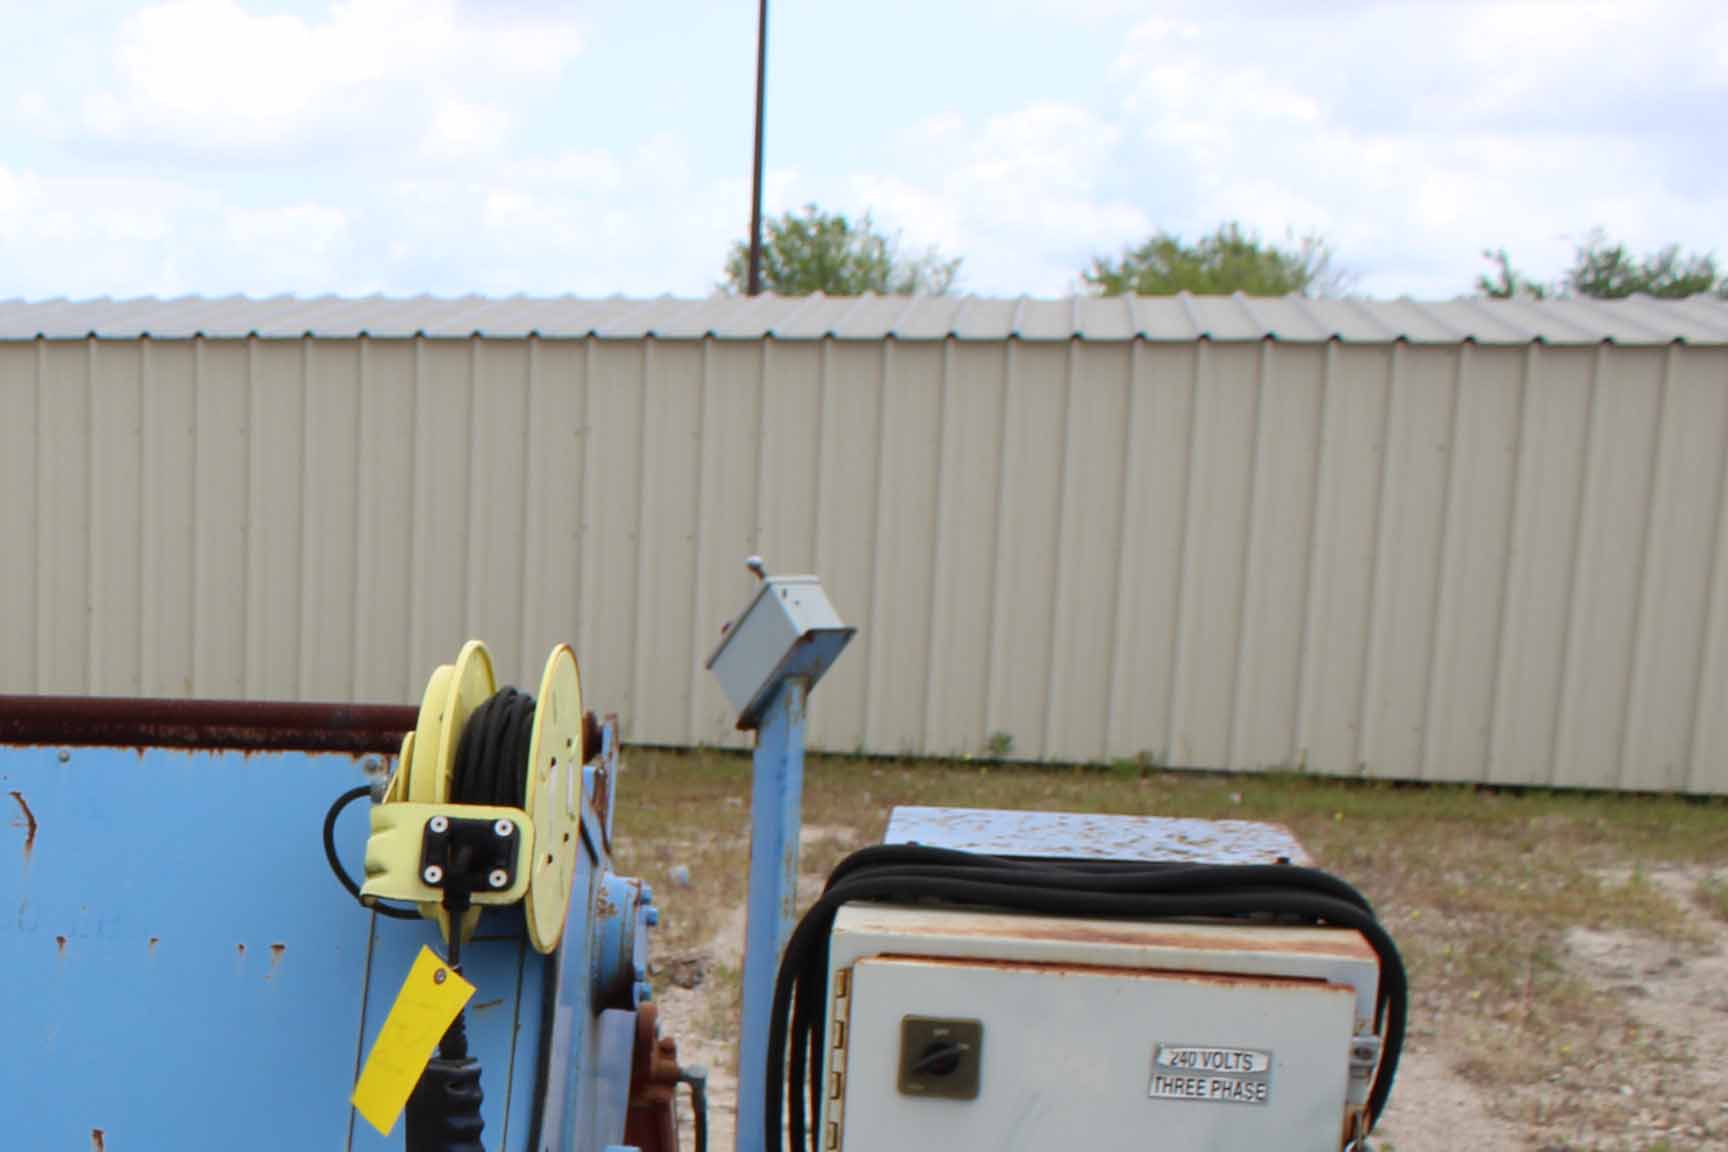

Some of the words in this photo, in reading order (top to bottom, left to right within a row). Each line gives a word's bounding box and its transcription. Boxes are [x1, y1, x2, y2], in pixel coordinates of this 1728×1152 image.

[1169, 1050, 1197, 1068] 240
[1199, 1051, 1254, 1072] VOLTS
[1154, 1075, 1207, 1097] THREE
[1210, 1079, 1266, 1101] PHASE
